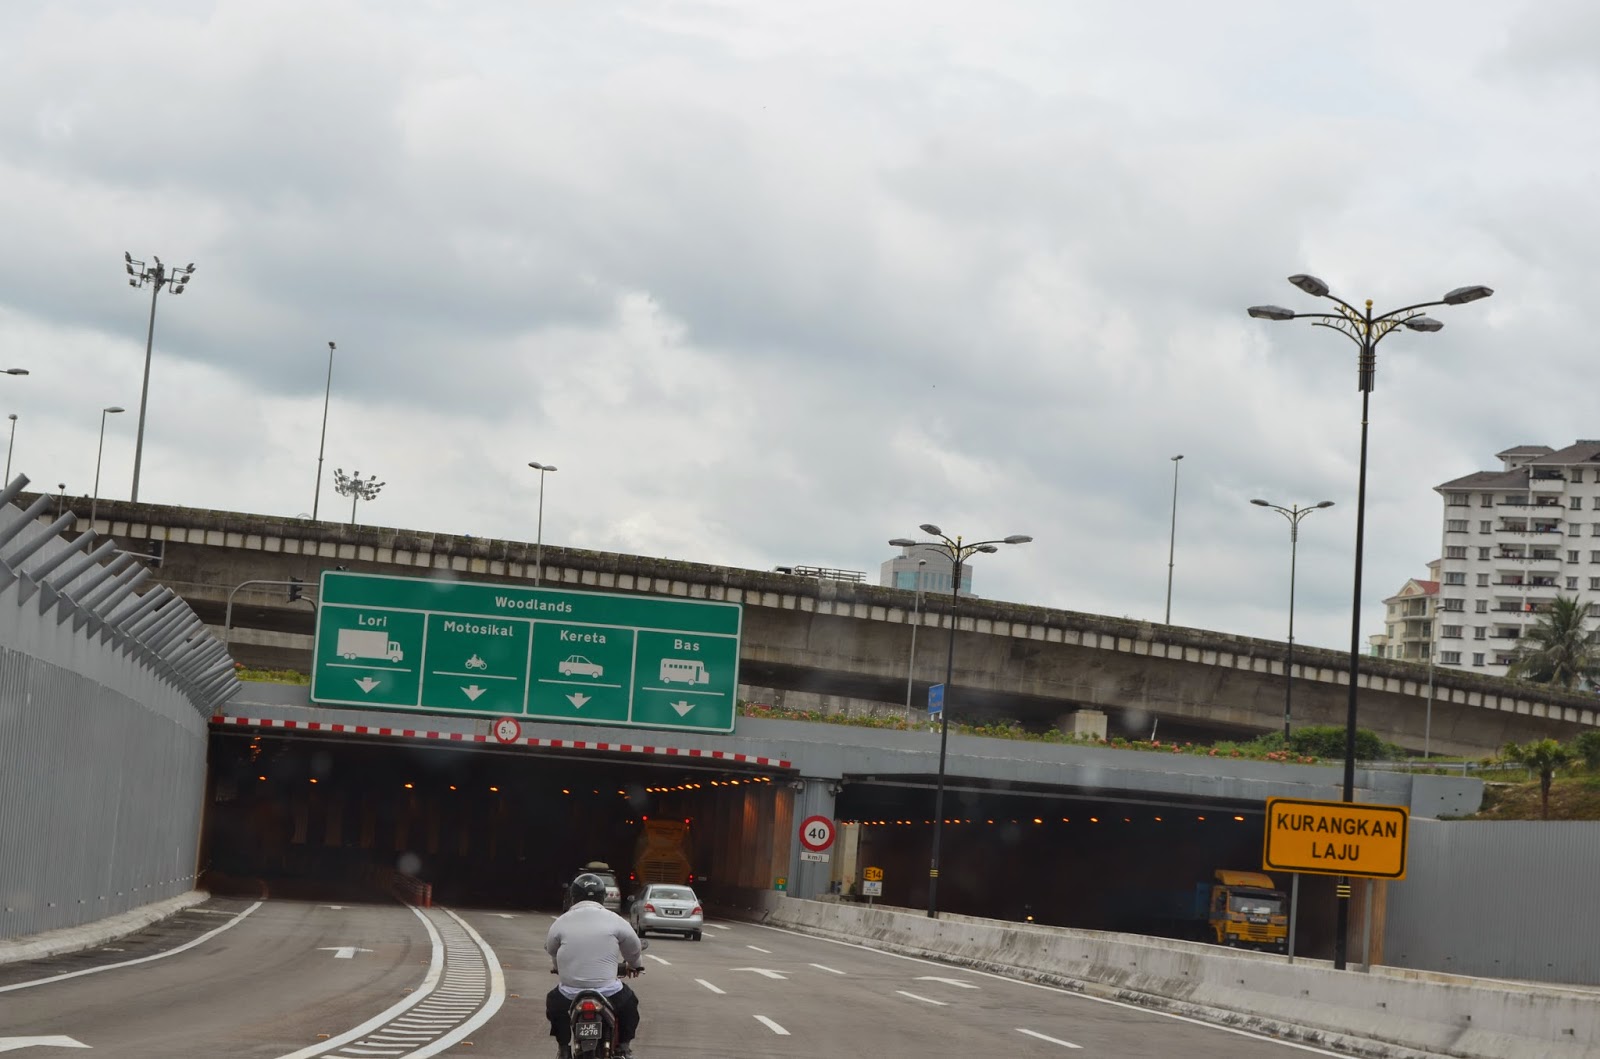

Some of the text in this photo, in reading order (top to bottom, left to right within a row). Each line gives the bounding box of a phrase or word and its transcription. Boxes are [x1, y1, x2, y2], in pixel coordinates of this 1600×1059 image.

[495, 596, 573, 613] Woodlands
[358, 614, 387, 628] Lori
[443, 621, 514, 637] Motosikal
[560, 630, 607, 644] Kereta
[674, 639, 700, 652] Bas
[1277, 813, 1397, 838] KURANGKAN
[808, 828, 826, 840] 40
[1312, 842, 1360, 861] LAJU
[865, 869, 882, 879] E14
